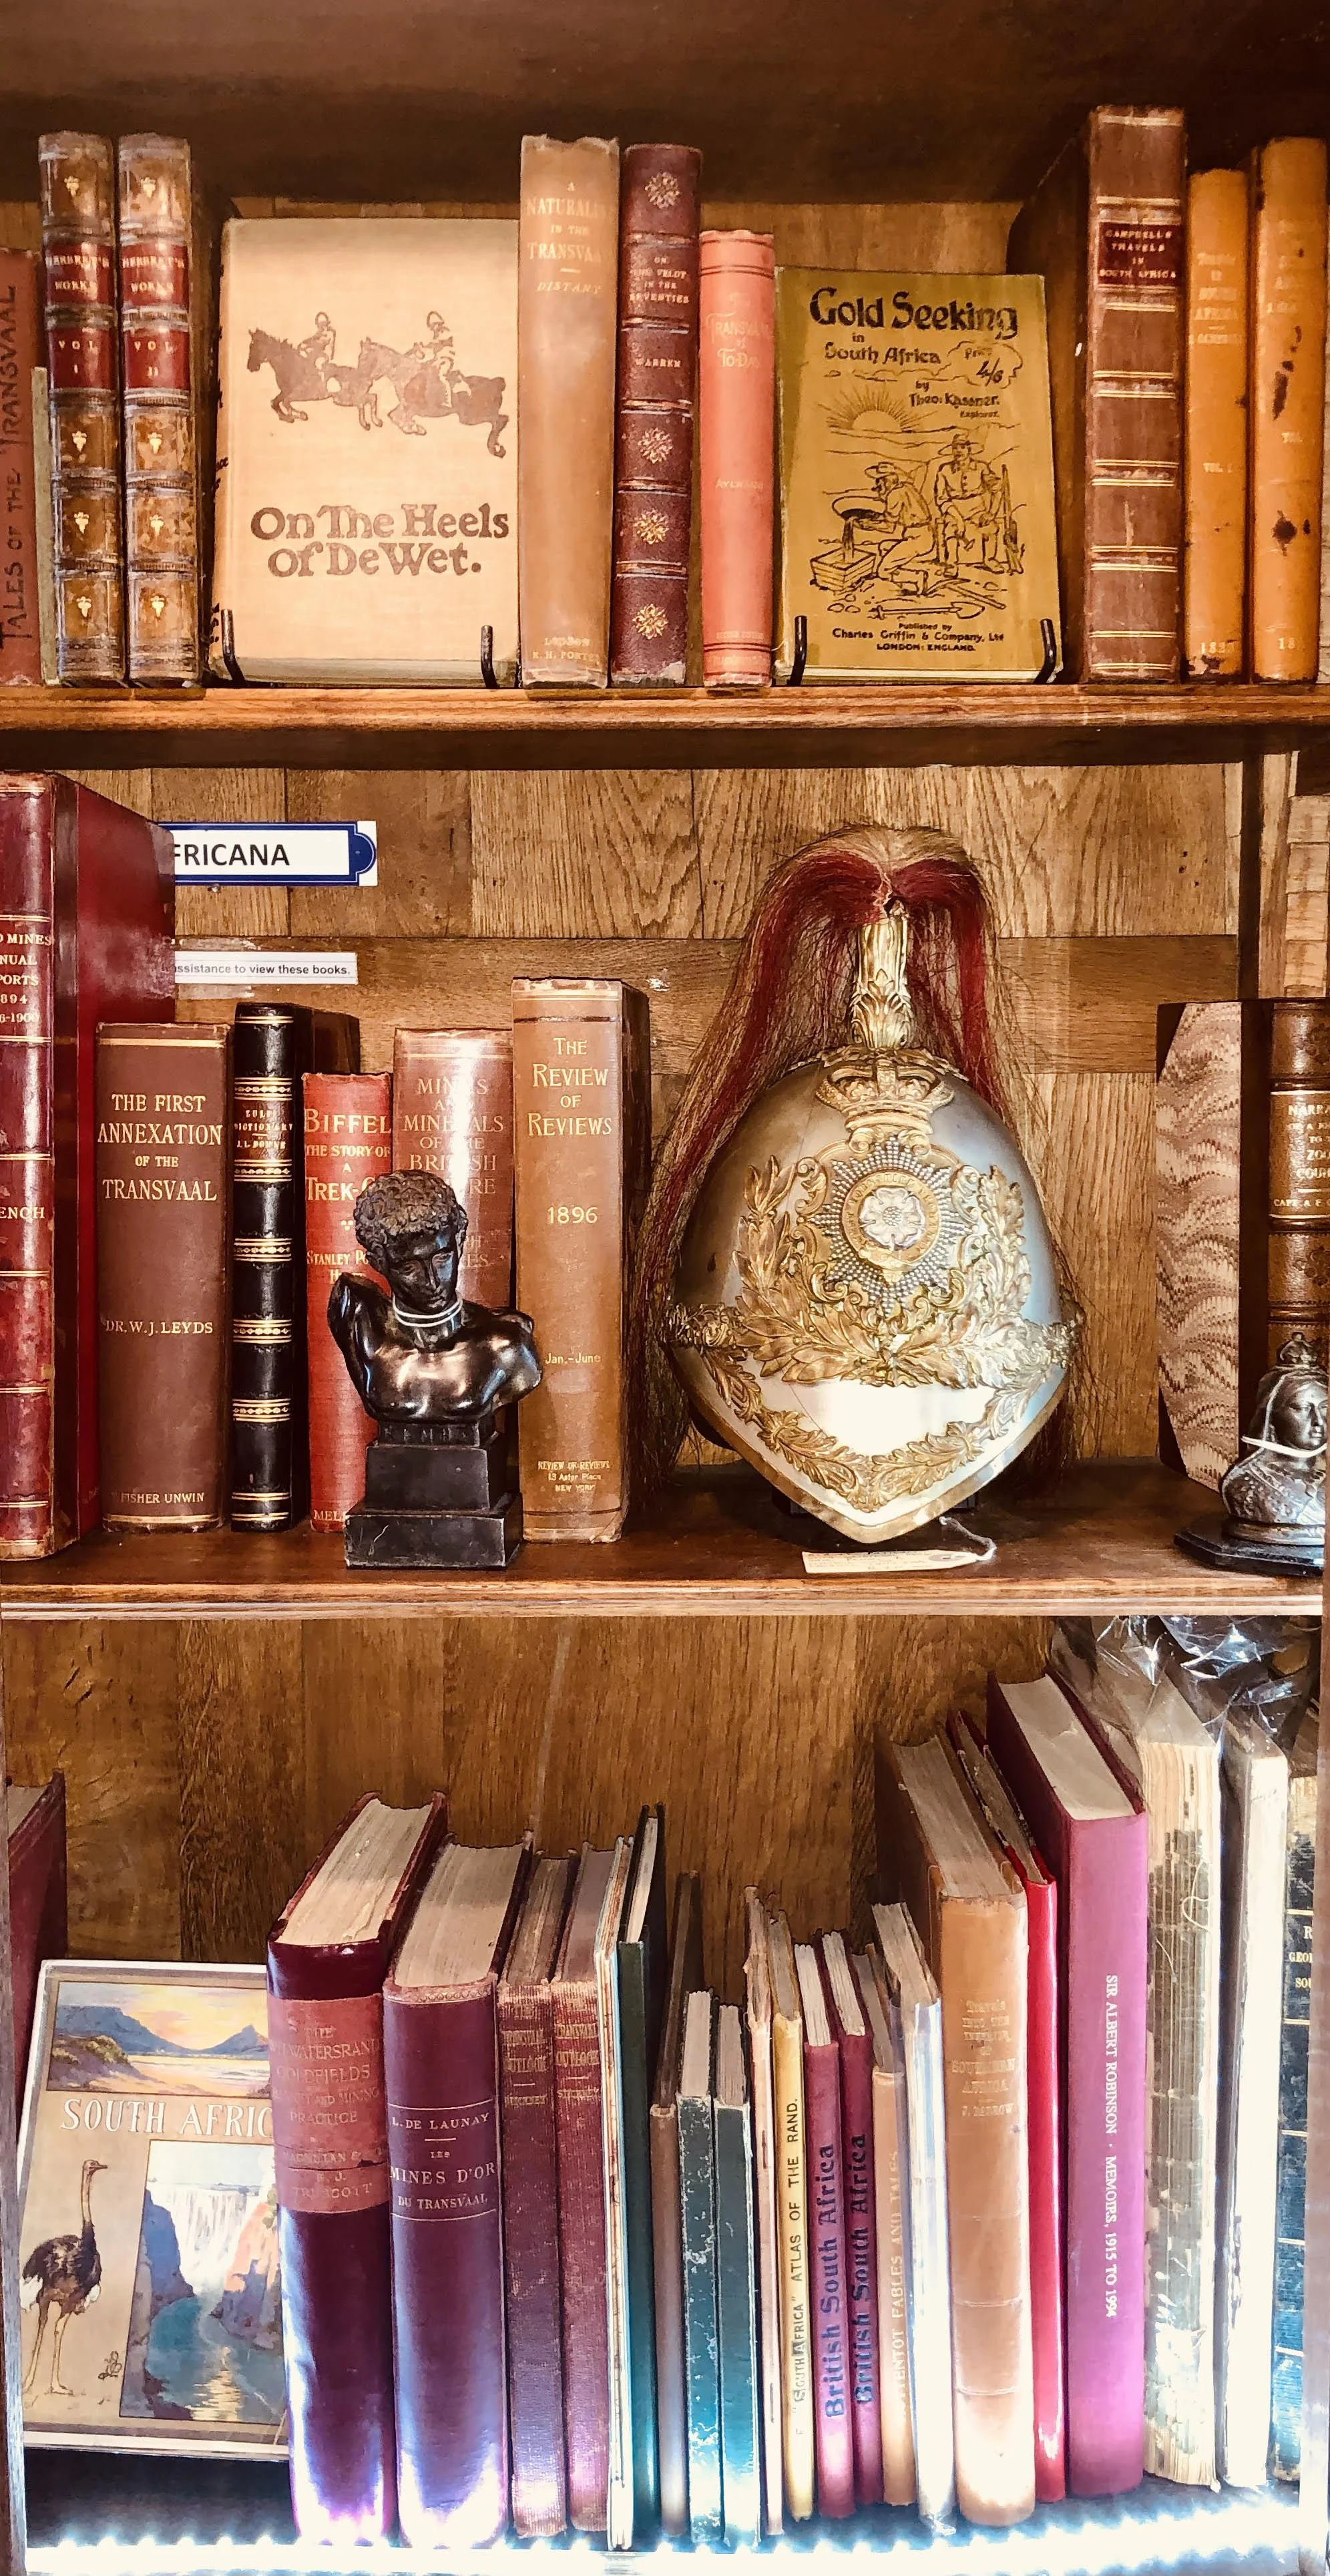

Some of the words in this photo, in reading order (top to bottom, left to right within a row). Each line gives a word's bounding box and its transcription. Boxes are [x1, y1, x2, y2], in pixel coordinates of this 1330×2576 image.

[525, 197, 609, 219] NATURALI
[527, 241, 603, 263] TRANSVA
[55, 281, 97, 292] WORKS
[131, 281, 174, 293] WORKS
[809, 287, 884, 328] Gold
[891, 291, 1018, 341] Seeking
[852, 333, 865, 343] in
[825, 342, 879, 365] South
[883, 347, 941, 365] Africa
[0, 285, 25, 454] TRANSVAAL
[915, 381, 930, 391] by
[250, 506, 314, 540] On
[316, 504, 395, 539] The
[401, 503, 509, 539] Heels
[268, 541, 324, 578] of
[0, 562, 32, 649] TALES
[832, 628, 873, 638] Charles
[880, 630, 915, 641] Griffin
[7, 933, 52, 946] MINES
[234, 964, 246, 974] to
[249, 964, 275, 974] view
[278, 964, 309, 975] these
[312, 965, 351, 975] books.
[417, 1077, 488, 1095] MINS
[112, 1094, 147, 1112] THE
[155, 1095, 206, 1113] FIRST
[560, 1095, 582, 1108] OF
[304, 1108, 391, 1134] BIFFEL
[402, 1115, 504, 1132] MINEALS
[97, 1123, 223, 1146] ANNEXATION
[420, 1137, 442, 1149] OF
[135, 1156, 150, 1167] OF
[155, 1156, 179, 1167] THE
[306, 1145, 327, 1157] THE
[331, 1145, 371, 1157] STORY
[375, 1146, 391, 1157] OF
[343, 1163, 353, 1173] A
[409, 1154, 497, 1171] BRISH
[102, 1179, 217, 1202] TRANSVAAL
[305, 1177, 375, 1201] TREK-
[0, 1206, 45, 1220] ENCH
[547, 1206, 598, 1224] 1896
[537, 1461, 564, 1470] REVIEW
[121, 1492, 160, 1503] FISHER
[164, 1492, 204, 1503] UNWIN
[555, 1484, 572, 1492] NEW
[1105, 1975, 1118, 1998] SIR
[1105, 2004, 1118, 2058] ALBERT
[1104, 2062, 1118, 2133] ROBINSON
[60, 2098, 166, 2133] SOUTH
[179, 2104, 273, 2139] AFRIC
[290, 2111, 359, 2126] PRACTICE
[406, 2120, 422, 2129] DE
[429, 2112, 490, 2129] LAUNAY
[786, 2098, 799, 2143] RAND.
[390, 2166, 445, 2185] MINES
[457, 2163, 495, 2183] D'OR
[788, 2158, 799, 2188] THE
[815, 2143, 837, 2225] Africa
[850, 2133, 869, 2215] Africa
[399, 2195, 411, 2207] DU
[417, 2193, 487, 2209] TRANSVAAL
[789, 2202, 801, 2221] OF
[1104, 2233, 1117, 2260] 1915
[790, 2235, 802, 2281] ATLAS
[853, 2228, 871, 2301] South
[818, 2237, 840, 2314] South
[1104, 2267, 1117, 2286] TO
[891, 2257, 904, 2318] FABLES
[853, 2312, 875, 2404] British
[820, 2324, 845, 2418] British
